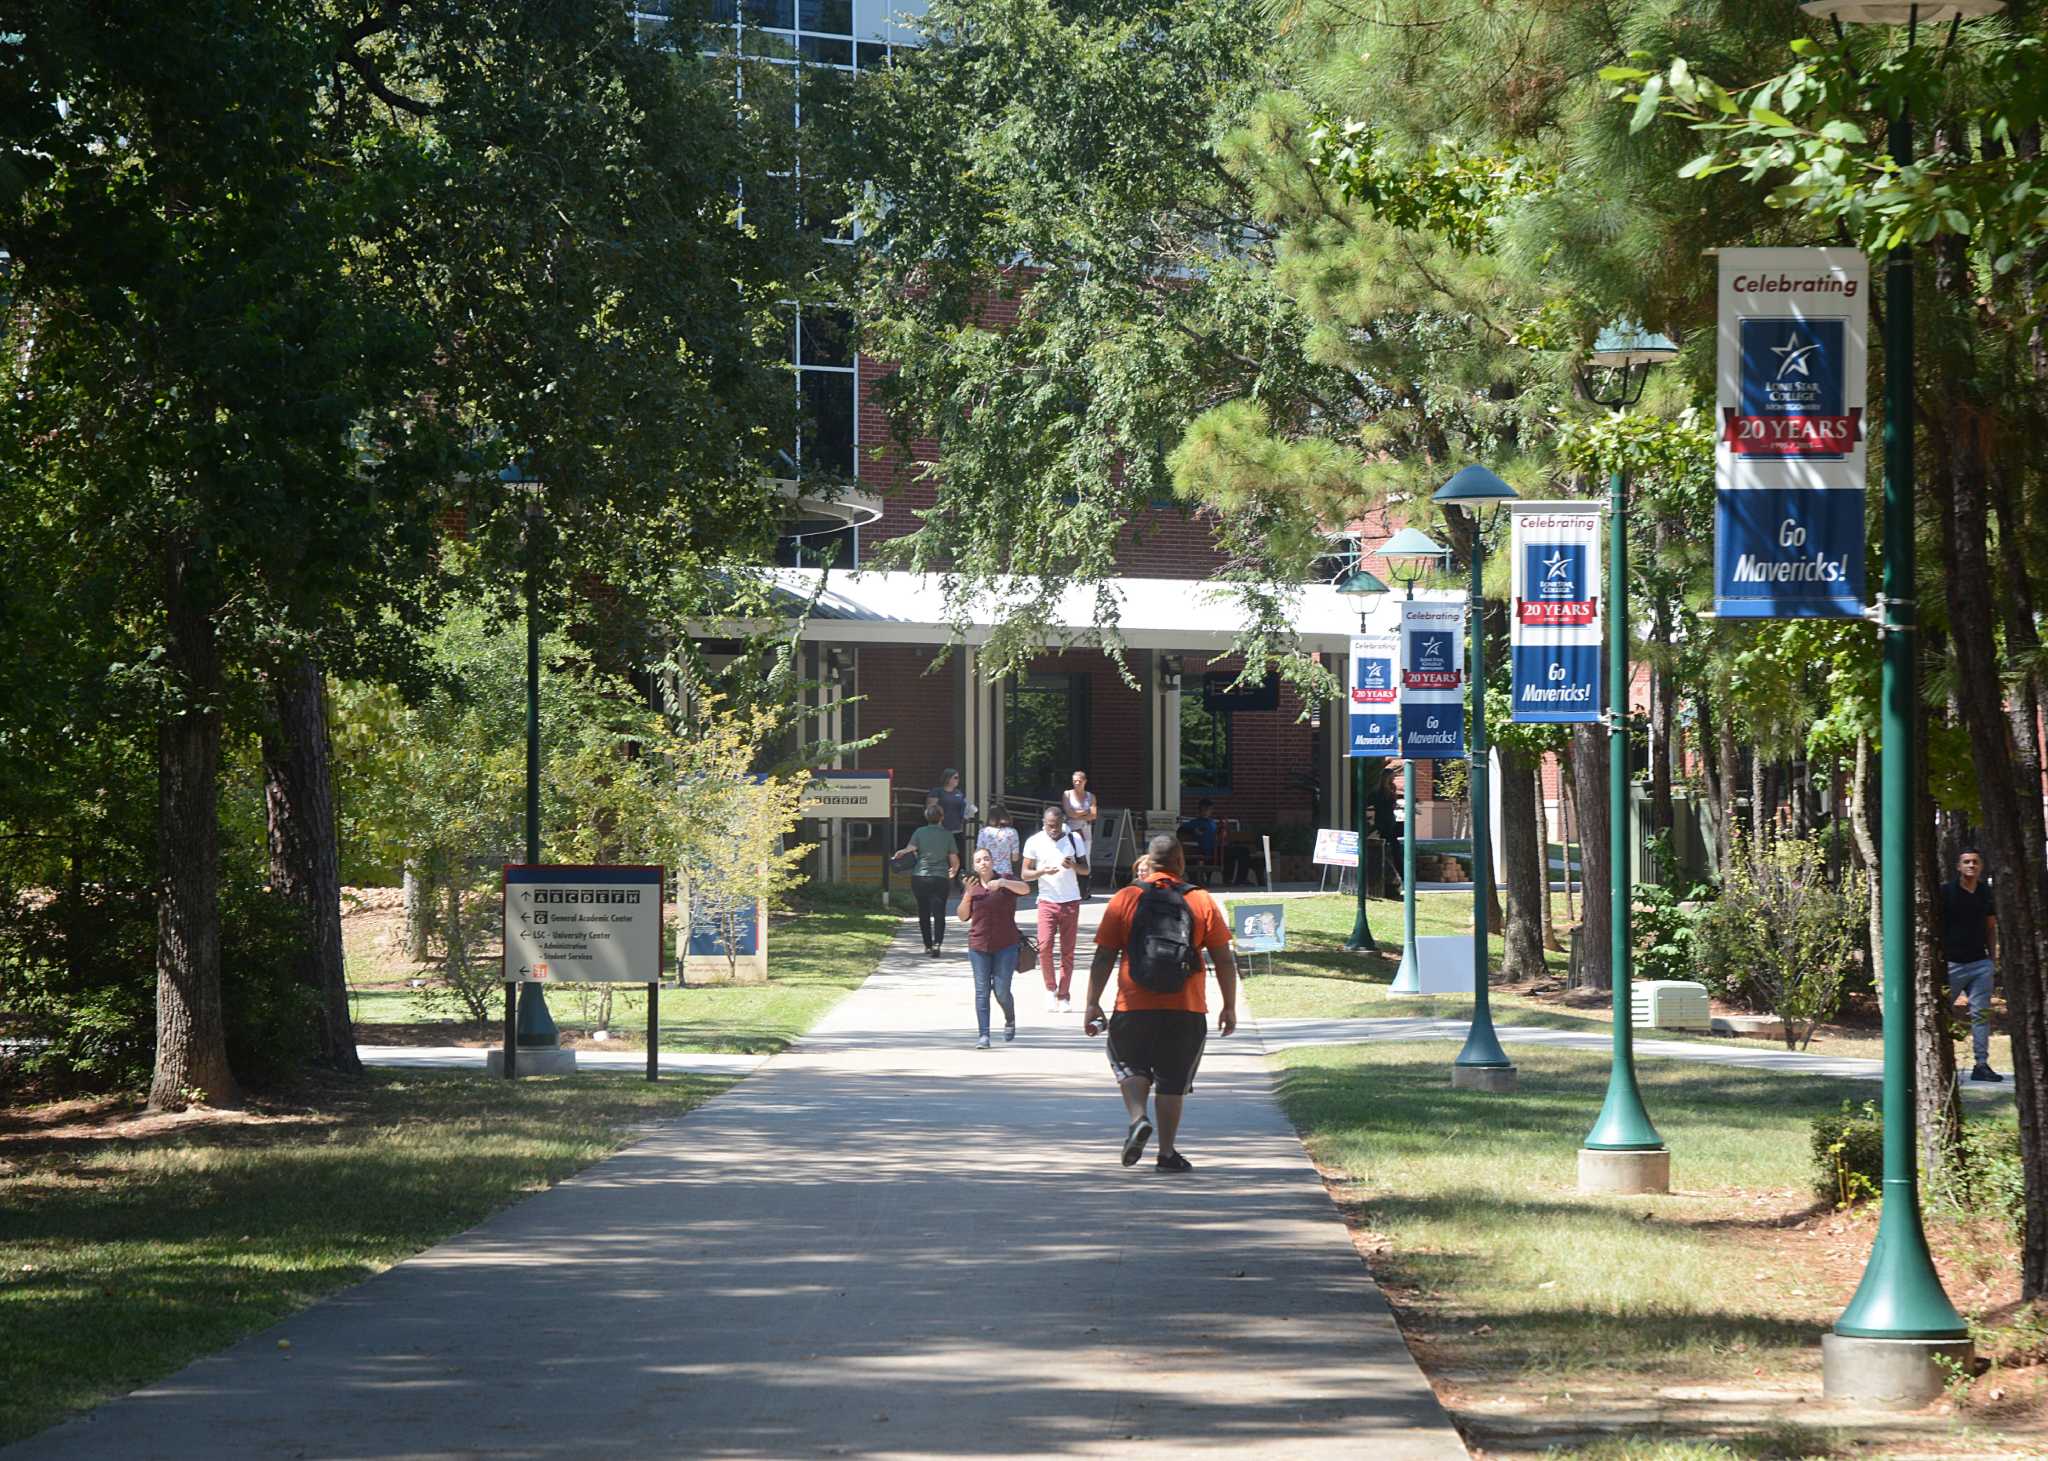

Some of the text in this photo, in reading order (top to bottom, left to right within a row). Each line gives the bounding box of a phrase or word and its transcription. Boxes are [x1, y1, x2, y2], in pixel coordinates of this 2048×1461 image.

[1733, 274, 1858, 297] Celebrating
[1738, 420, 1848, 439] 20 YEARS
[1520, 517, 1594, 531] Celebrating
[1779, 518, 1807, 547] Go
[1732, 551, 1849, 582] Mavericks!
[1407, 611, 1460, 622] Celebrating
[1524, 604, 1590, 616] 20 YEARS
[1408, 673, 1456, 683] 20 YEARS
[1548, 662, 1566, 681] Go
[1367, 690, 1393, 698] YEARS
[1521, 683, 1592, 702] Mavericks!
[1369, 723, 1380, 734] Go
[1426, 716, 1439, 729] Go
[1354, 735, 1395, 745] Mavericks!
[1407, 731, 1457, 744] Mavericks!
